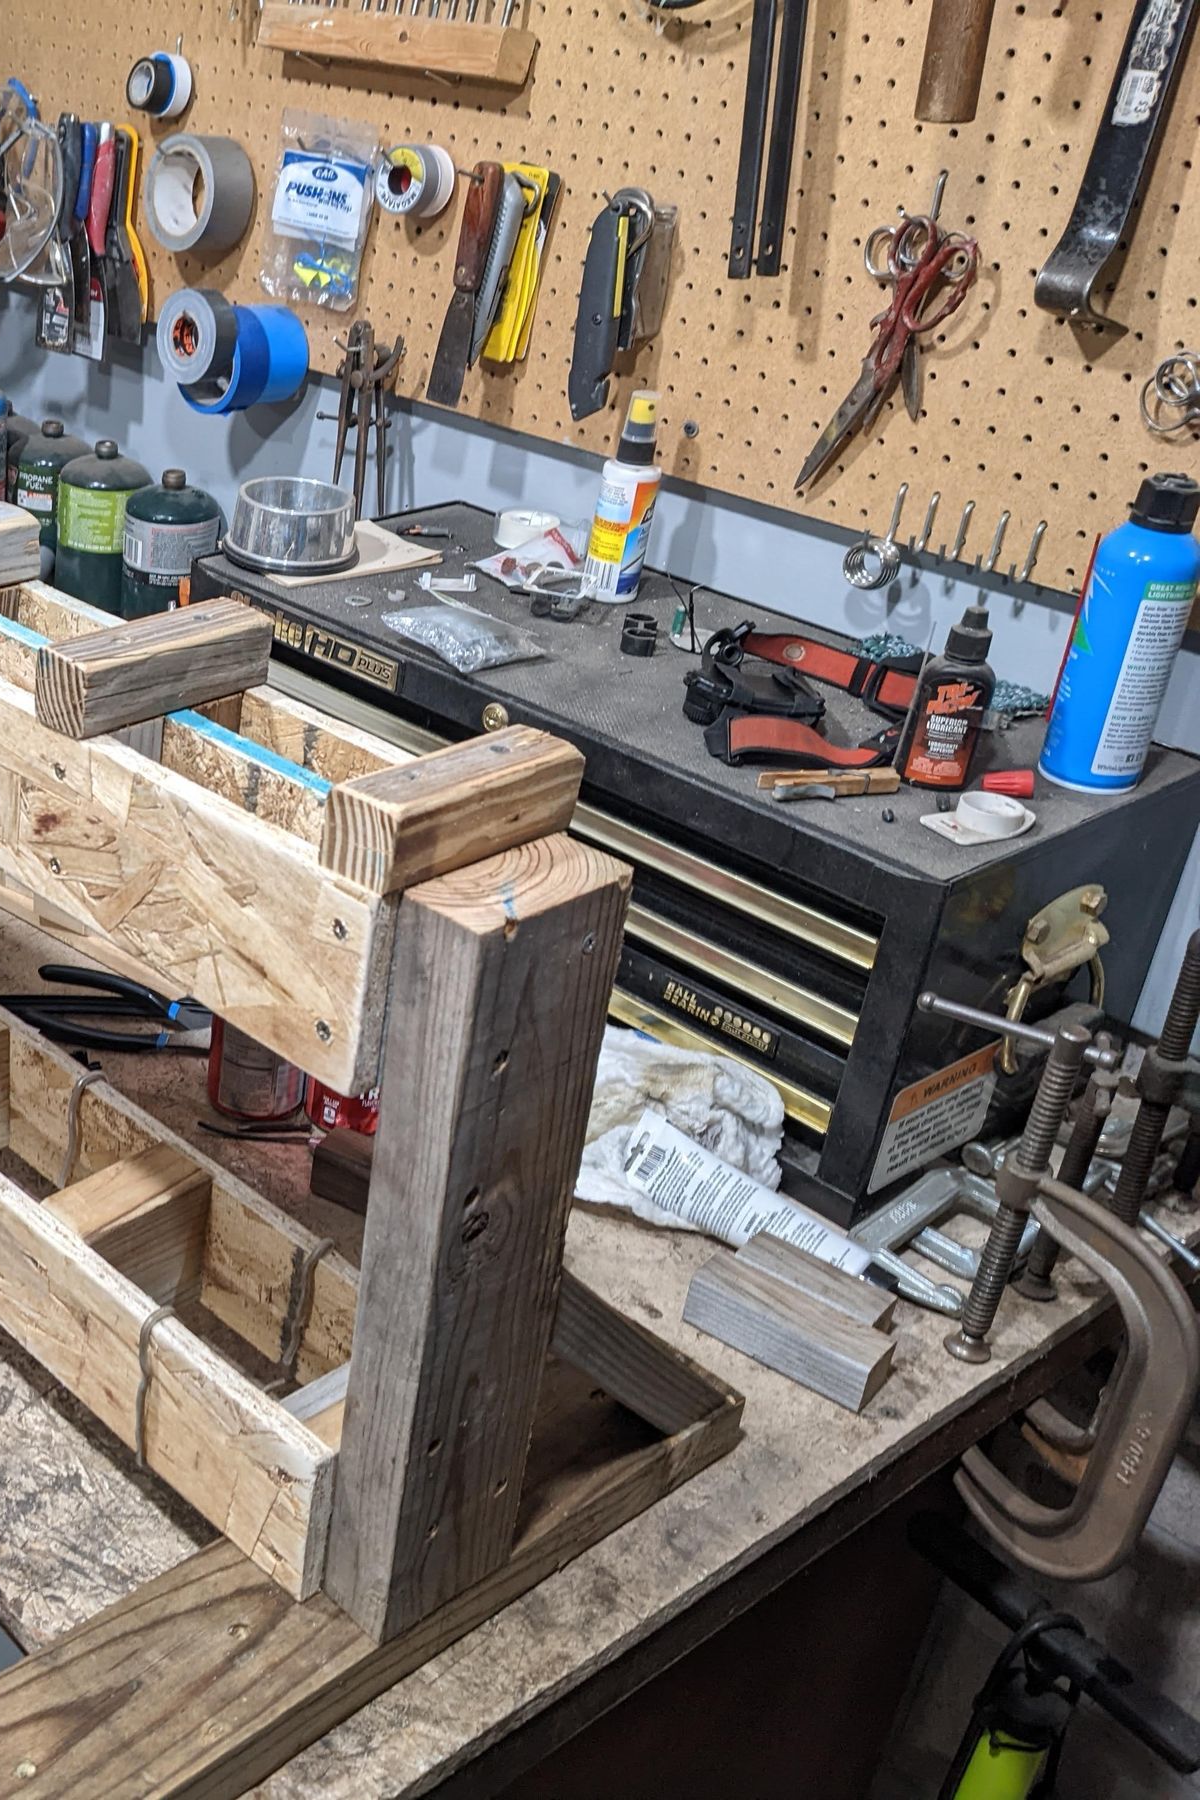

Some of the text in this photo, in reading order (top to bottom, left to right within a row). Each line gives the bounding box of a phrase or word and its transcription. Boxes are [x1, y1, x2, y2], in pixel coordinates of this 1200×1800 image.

[19, 471, 54, 485] PROPANE
[25, 481, 45, 491] FUEL
[1150, 583, 1175, 592] GREAT
[1147, 591, 1185, 599] LIGHTNING
[926, 720, 968, 734] LUBRICANT
[930, 714, 969, 726] SUPERIOR
[665, 981, 698, 1005] BALL
[663, 990, 720, 1026] BEARING
[923, 1062, 978, 1098] WARNING
